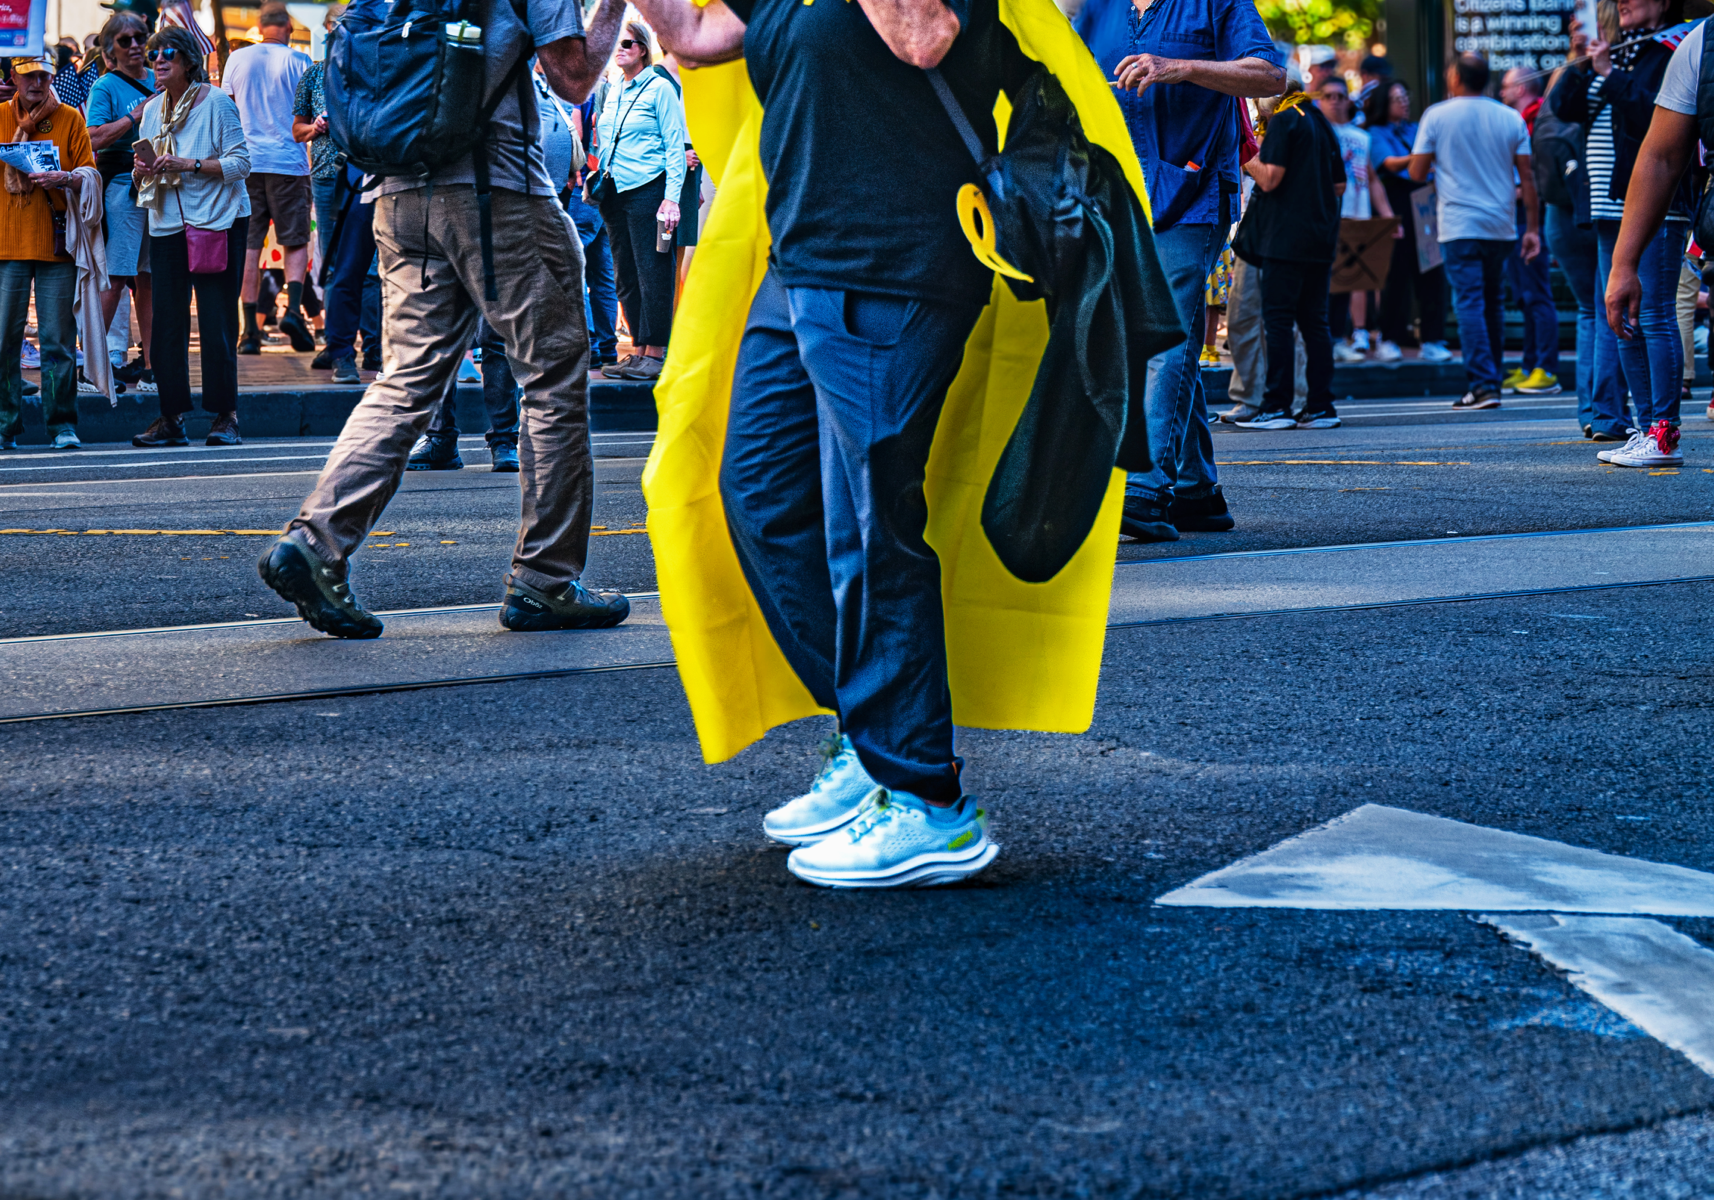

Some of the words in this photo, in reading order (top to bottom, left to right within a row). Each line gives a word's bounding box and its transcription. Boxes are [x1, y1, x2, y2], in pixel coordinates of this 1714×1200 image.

[1455, 14, 1469, 32] is
[1471, 17, 1483, 32] a
[1486, 13, 1562, 34] winning
[1455, 33, 1570, 51] combination
